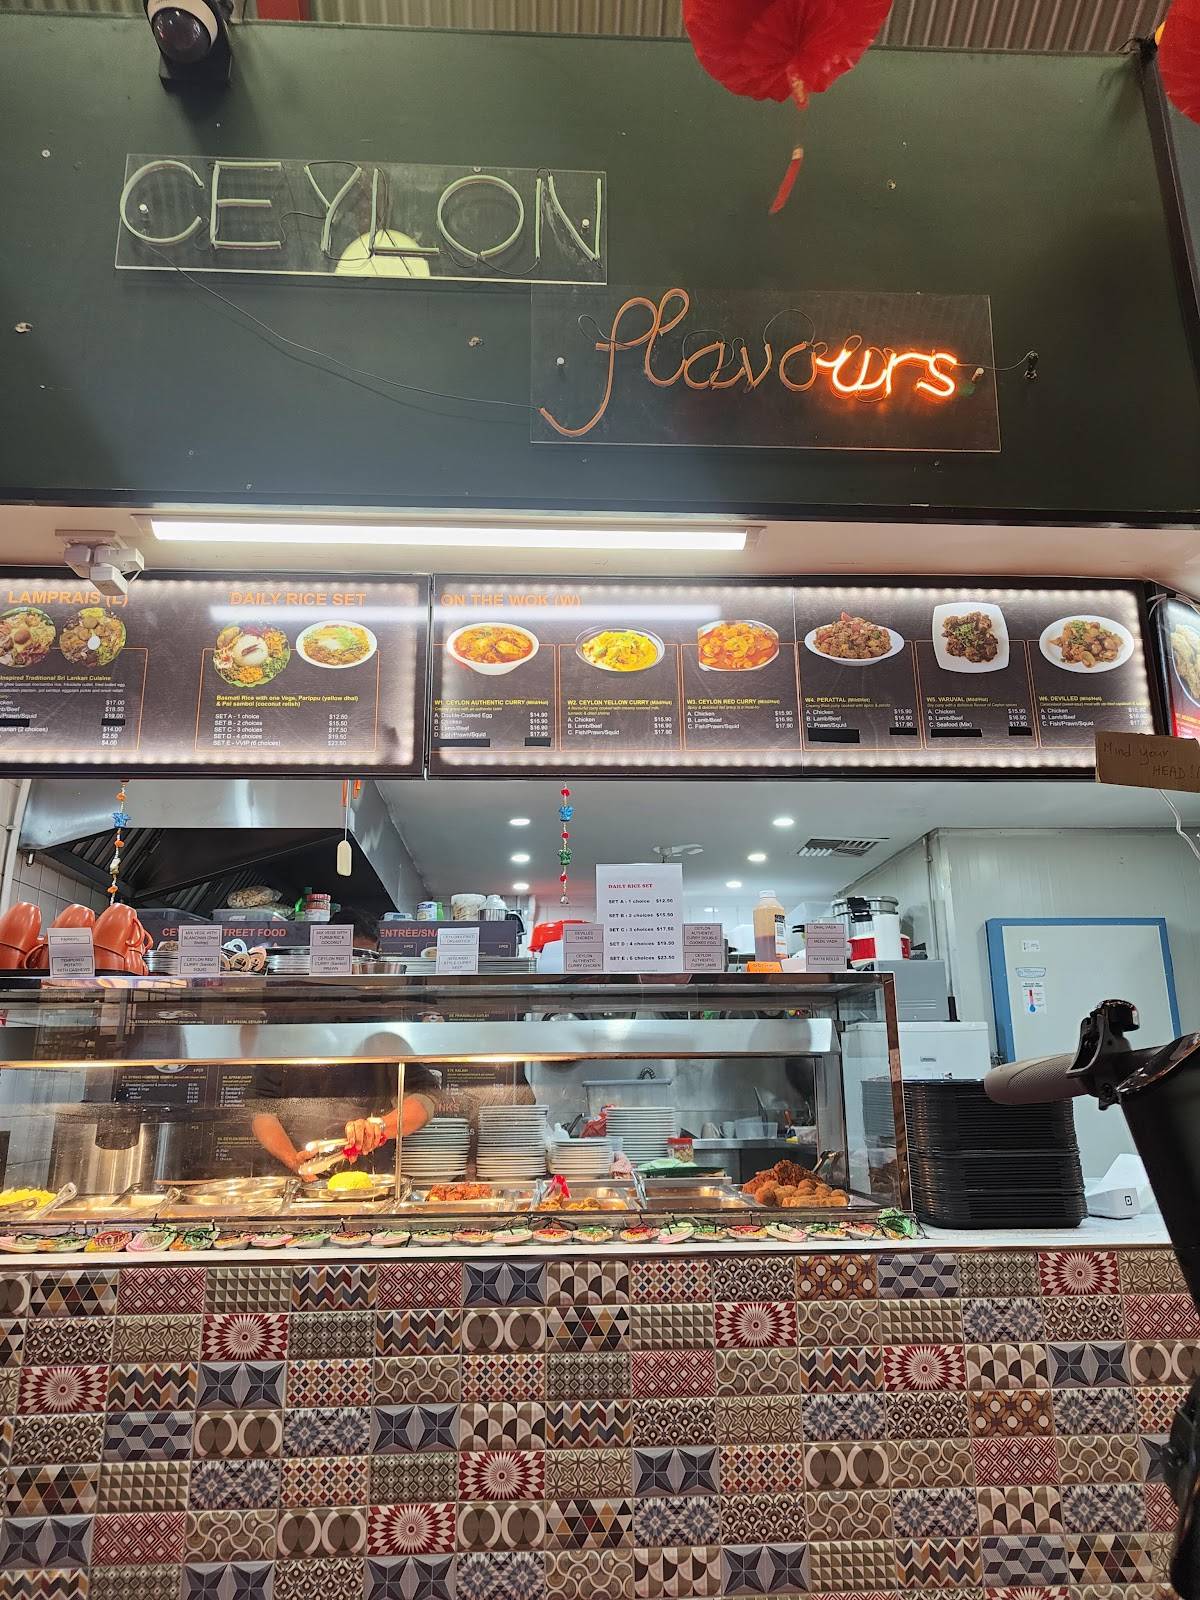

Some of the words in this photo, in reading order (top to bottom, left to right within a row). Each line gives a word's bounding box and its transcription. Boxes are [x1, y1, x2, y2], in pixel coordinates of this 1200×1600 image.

[120, 159, 602, 262] CEYLON
[538, 288, 957, 437] flavours
[7, 591, 101, 604] LAMPRAIS
[228, 592, 282, 606] DAILY
[285, 592, 328, 606] RICE
[331, 592, 367, 606] SET
[440, 592, 465, 608] ON
[470, 592, 504, 608] THE
[507, 592, 548, 608] WOK
[553, 592, 582, 608] (W)
[1104, 742, 1131, 758] Mind
[1139, 747, 1169, 766] your
[162, 928, 180, 936] CEY
[222, 928, 256, 936] TREET
[257, 928, 287, 936] FOOD
[380, 927, 438, 938] ENTRÉE/SNA
